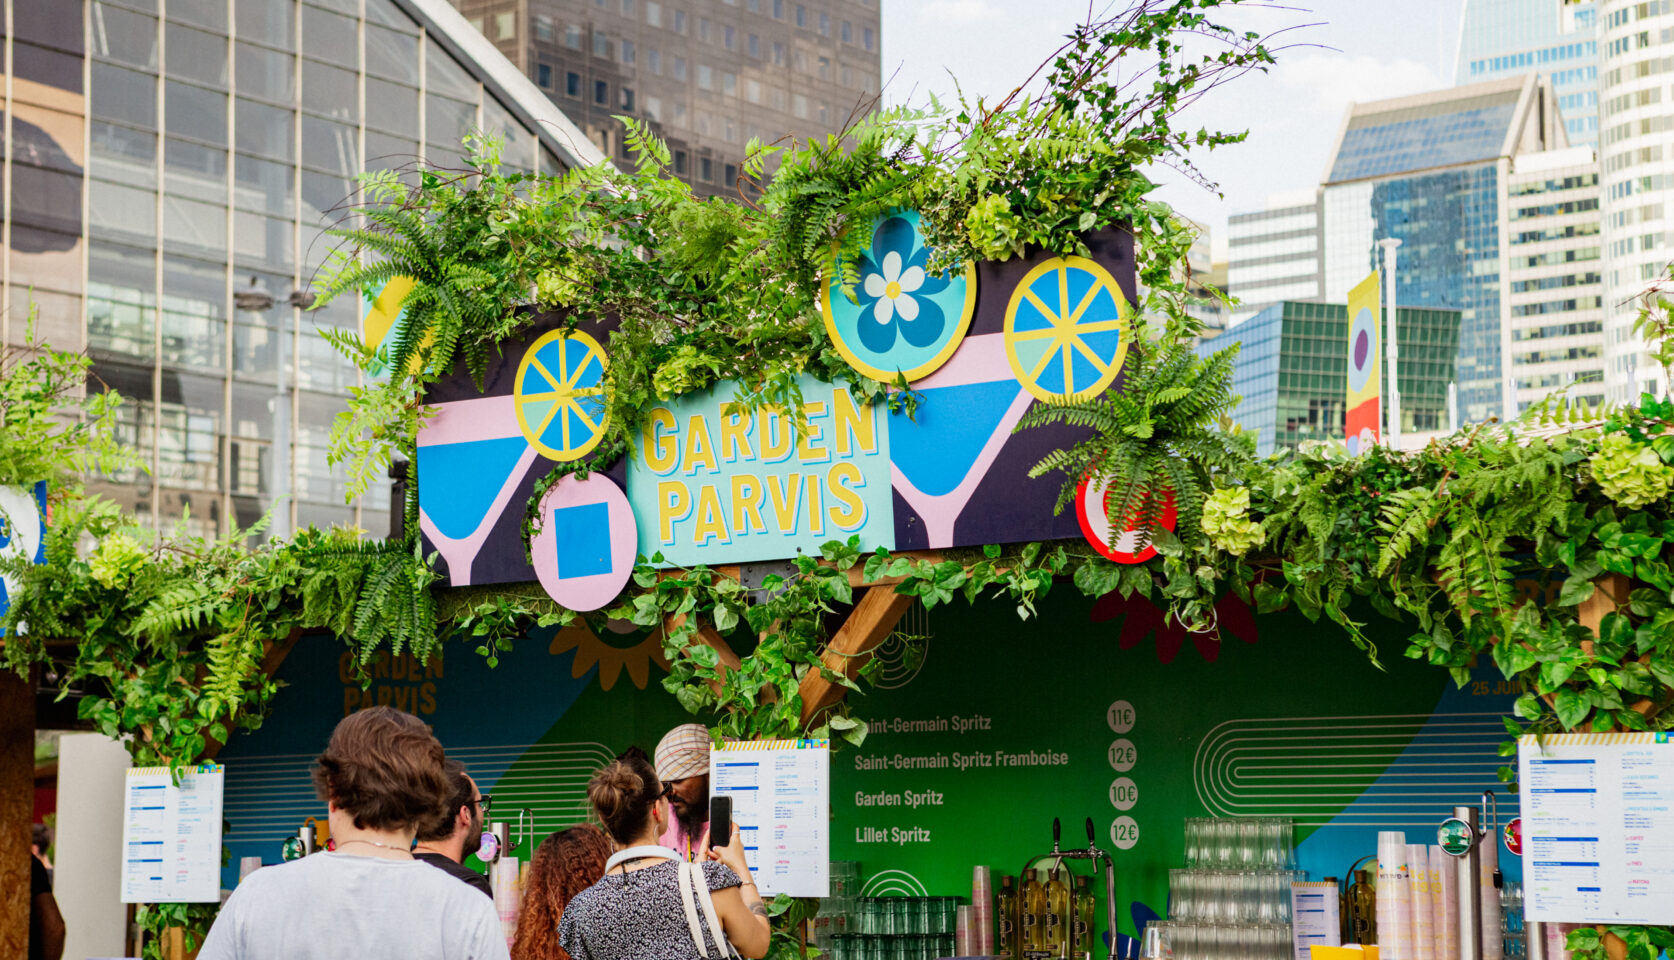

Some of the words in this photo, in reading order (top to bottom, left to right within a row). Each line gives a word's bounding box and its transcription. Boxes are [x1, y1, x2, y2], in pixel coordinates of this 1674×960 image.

[642, 387, 878, 476] GARDEN
[658, 462, 868, 546] PARVIS
[1471, 681, 1489, 696] 25
[951, 714, 992, 735] Spritz
[1111, 708, 1133, 726] 11€
[854, 752, 949, 771] Saint-Germain
[952, 750, 993, 772] Spritz
[995, 749, 1069, 768] Framboise
[1111, 747, 1135, 764] 12€
[854, 790, 901, 807] Garden
[904, 789, 944, 809] Spritz
[1111, 785, 1136, 802] 10€
[855, 825, 889, 843] Lillet
[891, 826, 931, 846] Spritz
[1113, 824, 1137, 841] 12€
